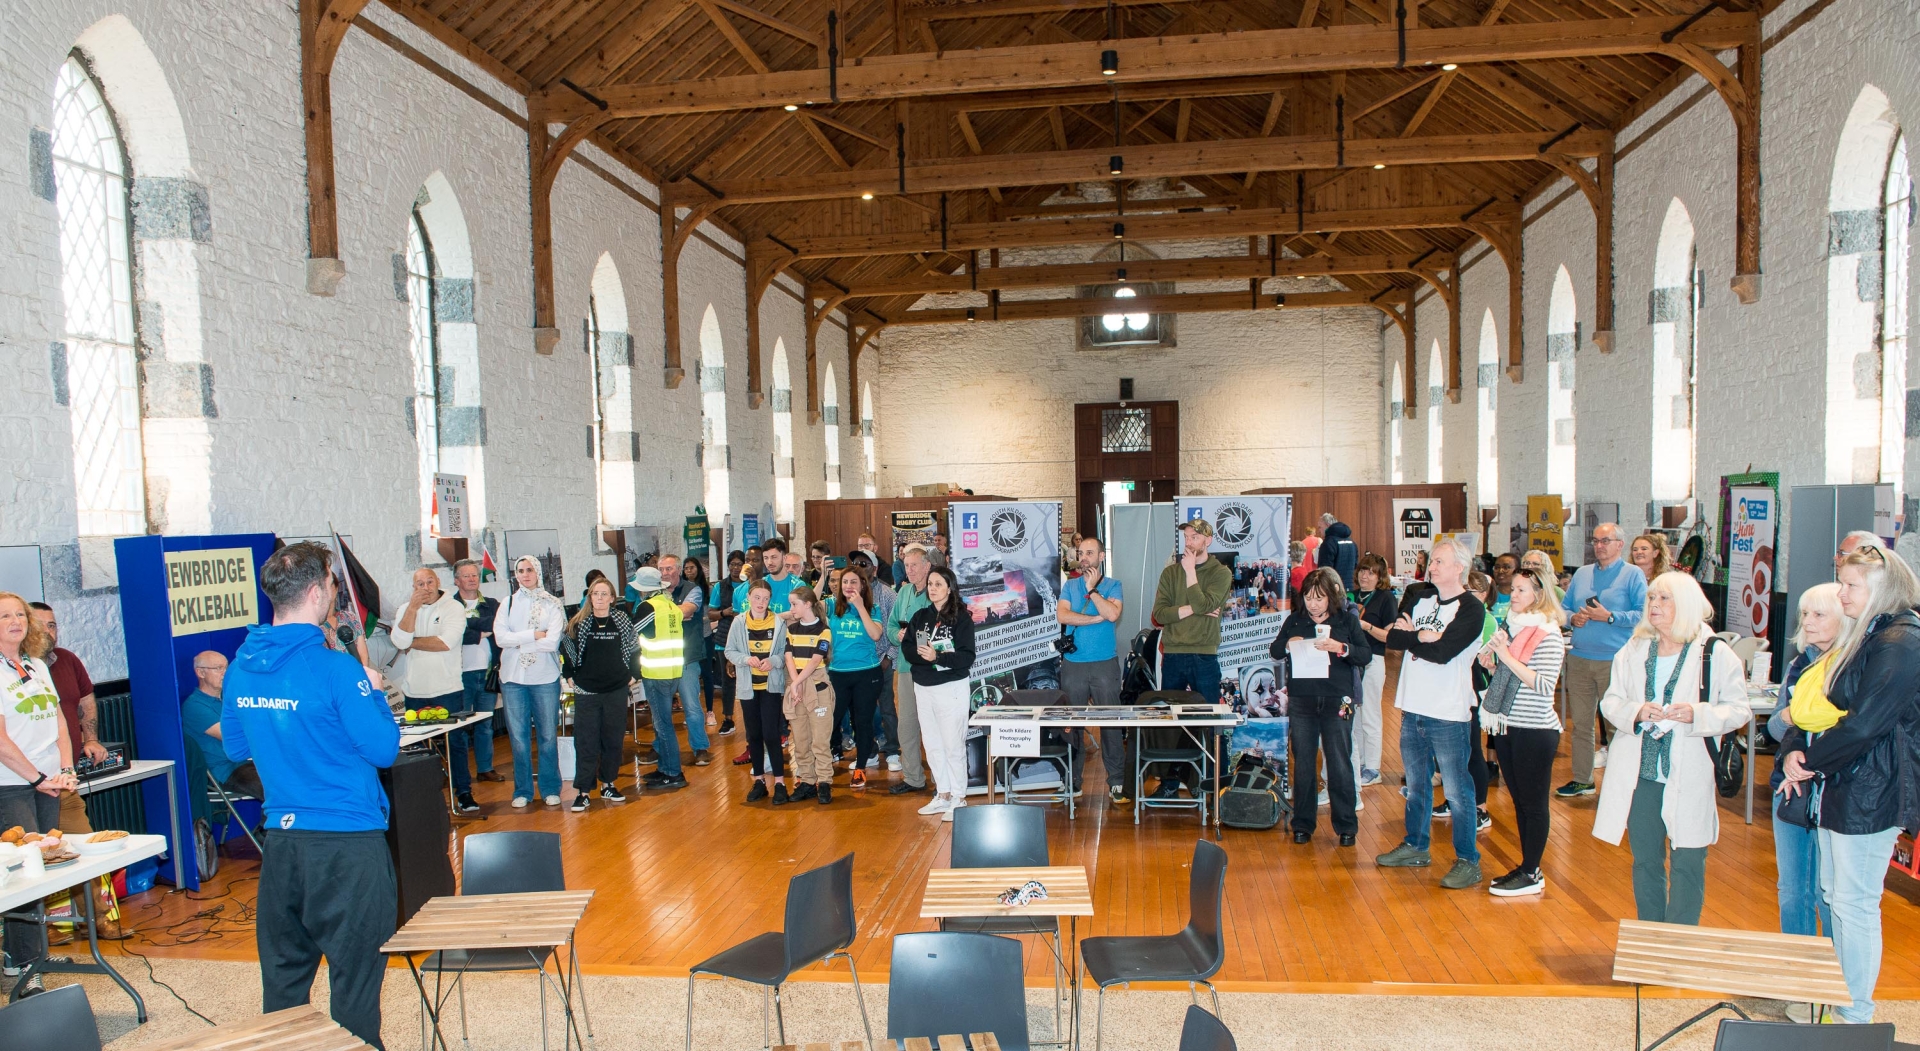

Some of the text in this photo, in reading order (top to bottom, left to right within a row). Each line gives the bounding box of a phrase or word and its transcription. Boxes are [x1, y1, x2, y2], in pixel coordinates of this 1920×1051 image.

[989, 506, 1028, 521] SOUTH KILDARE
[1214, 501, 1254, 517] SOUTH KILDARE
[1736, 521, 1755, 539] June
[988, 537, 1029, 554] PHOTOGRAPHY CLUB
[1213, 532, 1255, 549] PHOTOGRAPHY CLUB
[1732, 533, 1753, 552] Fest
[170, 592, 249, 626] ICKLEBALL
[978, 629, 1001, 642] KILDARE
[1001, 617, 1042, 635] PHOTOGRAPHY
[1042, 613, 1056, 624] CLUB
[1225, 618, 1266, 632] PHOTOGRAPHY
[1266, 614, 1282, 624] CLUB
[975, 641, 992, 653] EVERY
[993, 634, 1021, 648] THURSDAY
[1021, 629, 1039, 640] NIGHT
[1039, 626, 1046, 635] AT
[1046, 623, 1058, 633] 8PM
[1220, 633, 1245, 643] URSDAY
[1244, 628, 1263, 638] NIGHT
[1263, 627, 1270, 635] AT
[983, 657, 990, 666] OF
[990, 646, 1027, 663] PHOTOGRAPHY
[1028, 640, 1049, 653] CATERED
[1218, 643, 1271, 659] OTOGRAPHY CATERE
[972, 650, 1049, 678] A WARM WELCOME AWAITS YOU
[1220, 652, 1272, 668] ELCOME AWAITS YOU
[236, 696, 299, 711] SOLIDARITY
[30, 712, 45, 721] FOR
